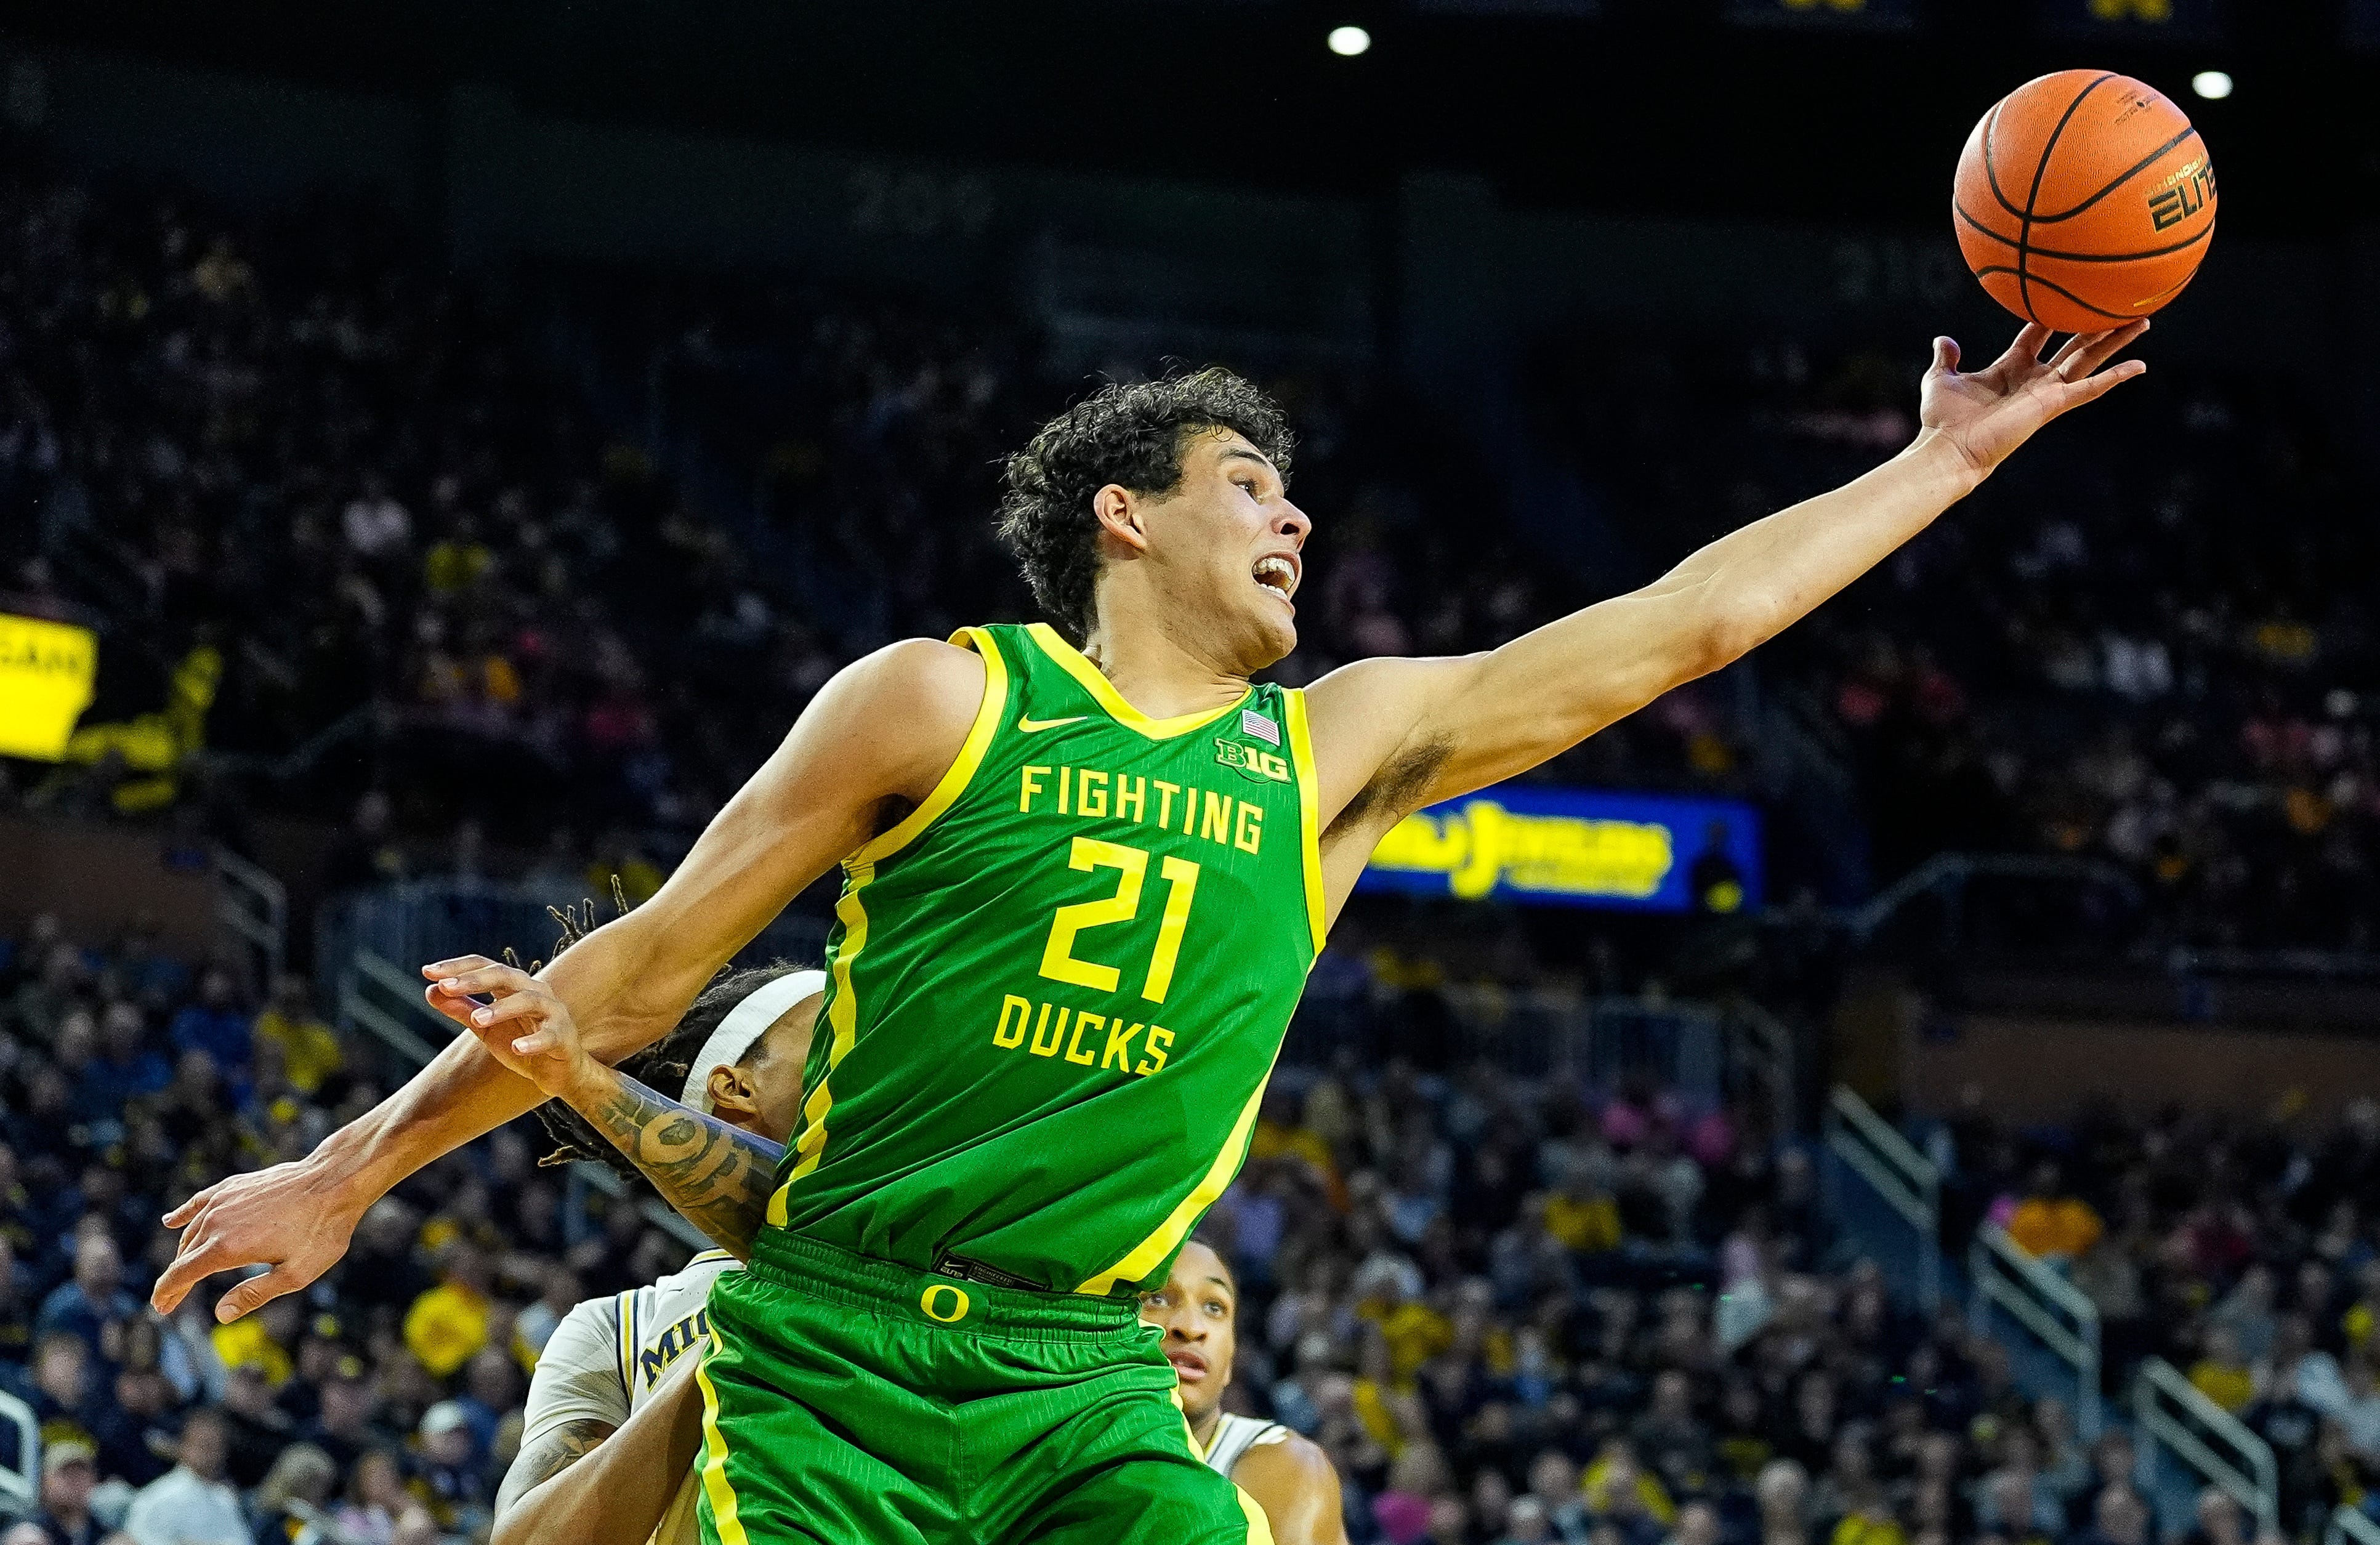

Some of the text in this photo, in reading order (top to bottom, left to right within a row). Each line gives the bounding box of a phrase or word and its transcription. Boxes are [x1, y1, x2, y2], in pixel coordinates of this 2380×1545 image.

[1019, 766, 1264, 855] FIGHTING
[1038, 836, 1200, 1004] 21
[992, 994, 1176, 1076] DUCKS
[921, 1283, 970, 1323] O
